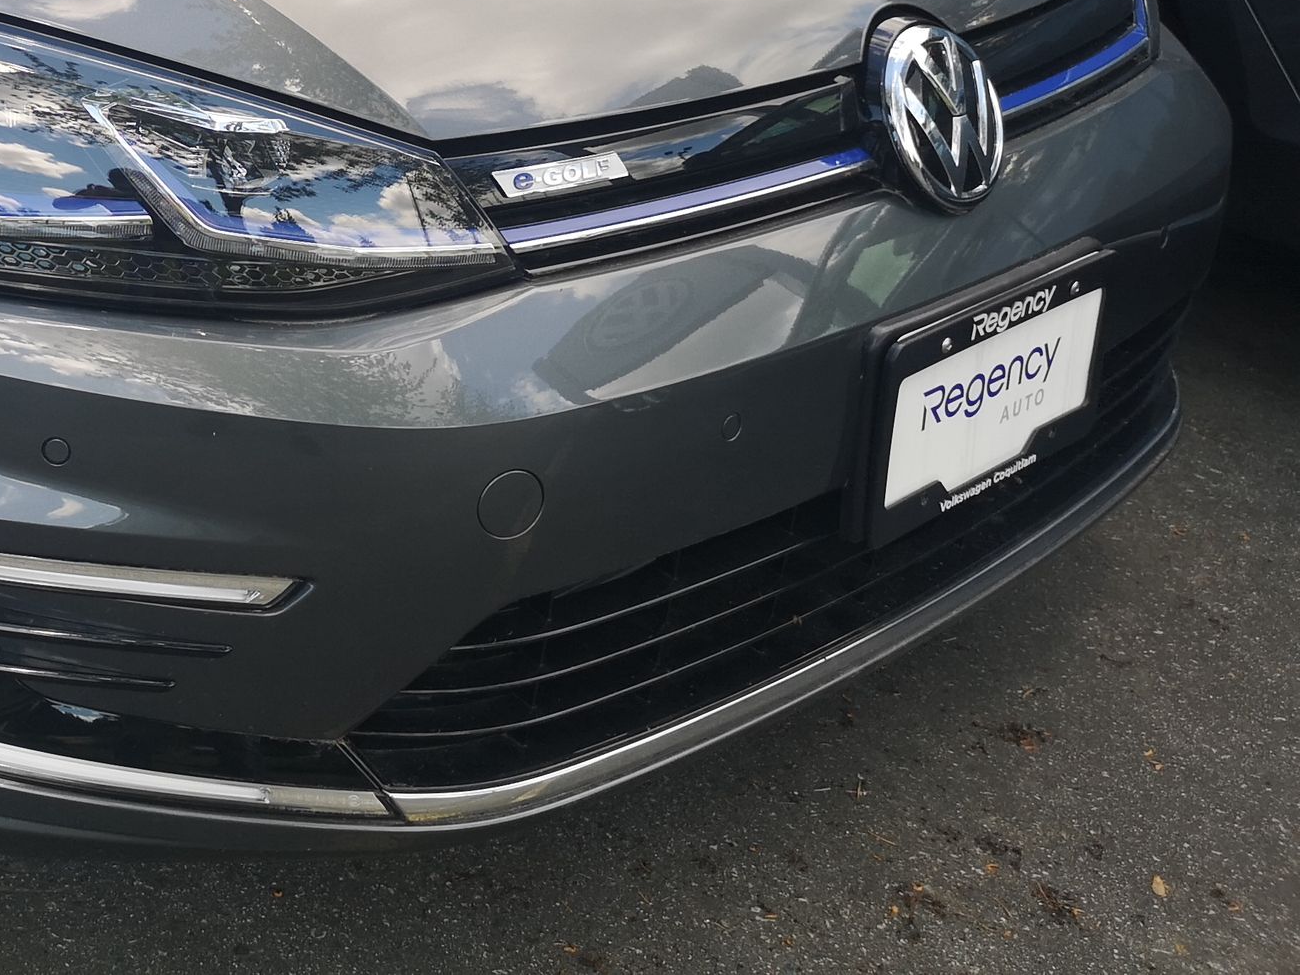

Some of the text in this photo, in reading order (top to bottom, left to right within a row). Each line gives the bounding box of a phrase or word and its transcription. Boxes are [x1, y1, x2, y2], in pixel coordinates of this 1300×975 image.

[971, 285, 1057, 341] Regency
[921, 337, 1062, 431] Regency
[1000, 388, 1045, 423] AUTO
[940, 454, 1037, 512] Volkswagen Coquitlam
